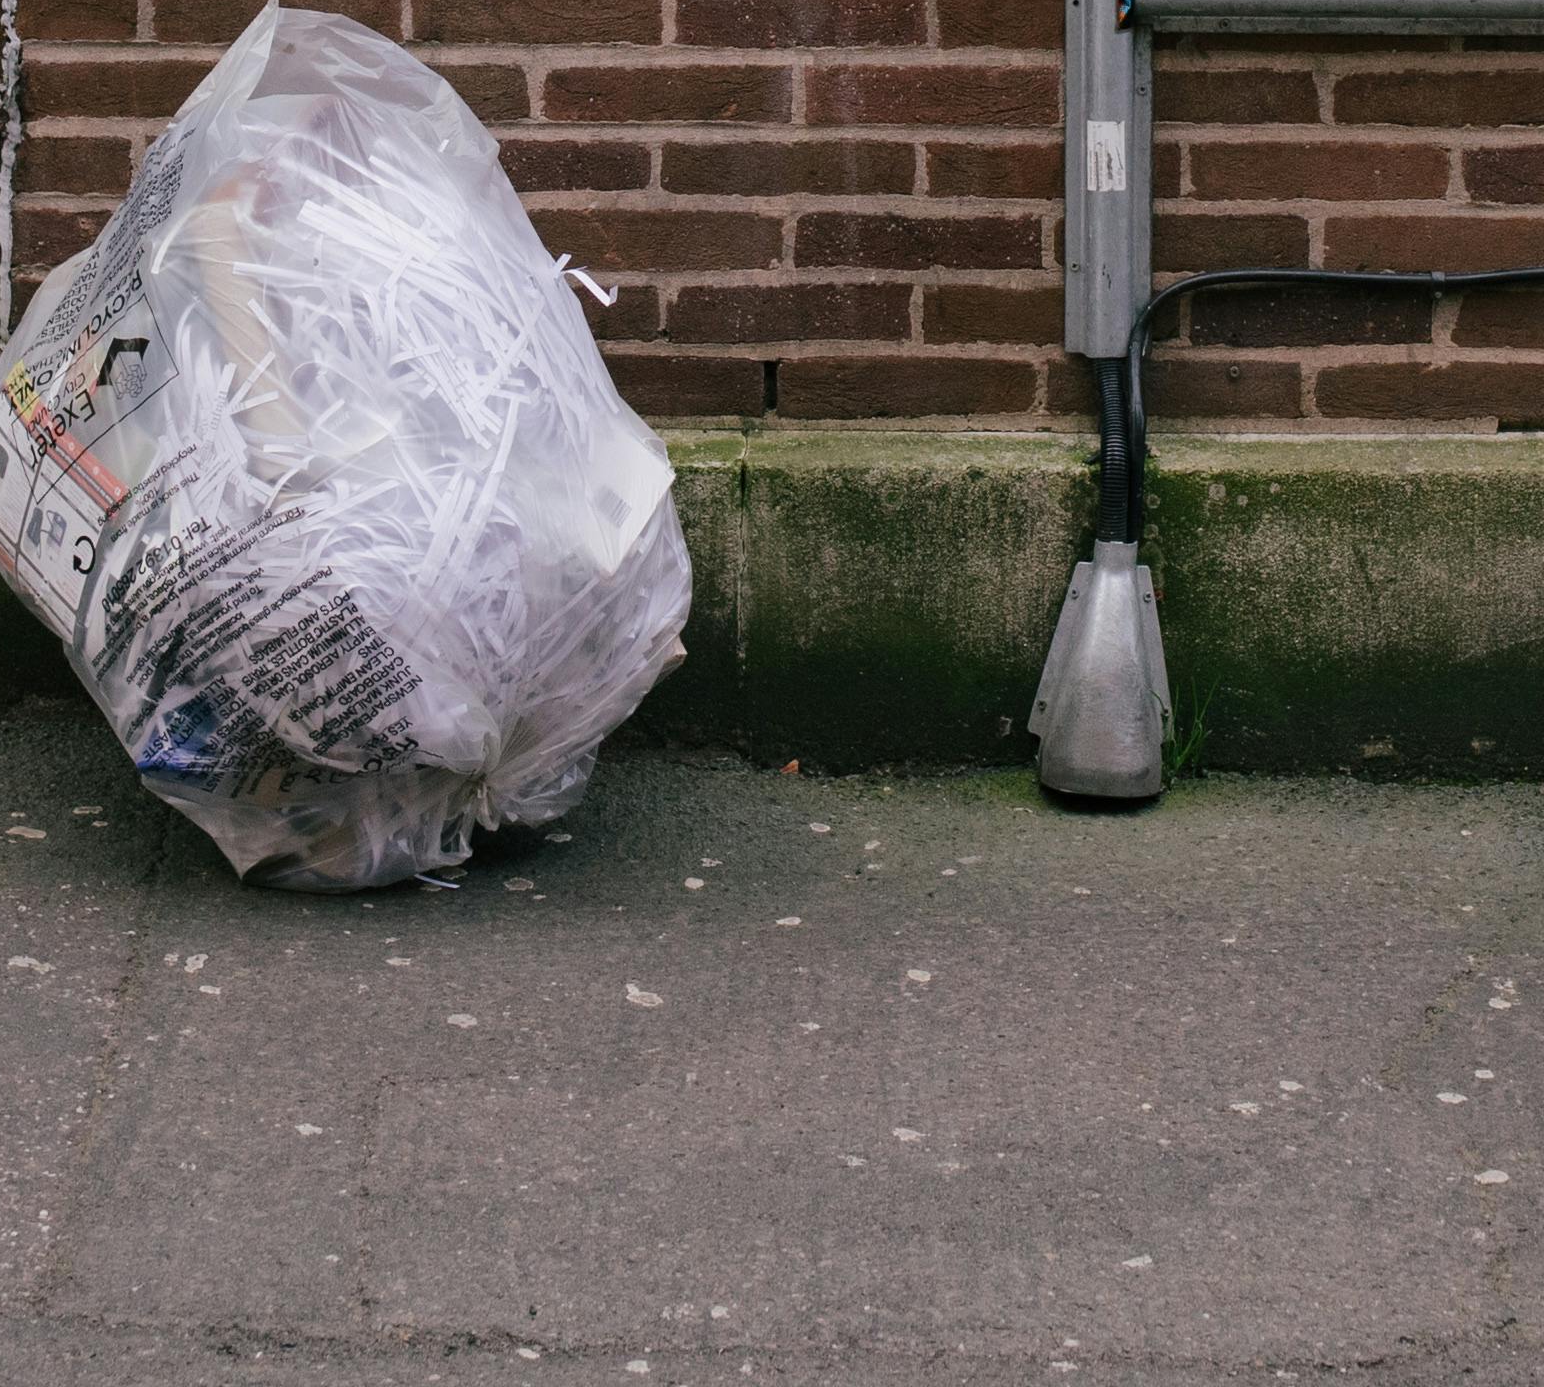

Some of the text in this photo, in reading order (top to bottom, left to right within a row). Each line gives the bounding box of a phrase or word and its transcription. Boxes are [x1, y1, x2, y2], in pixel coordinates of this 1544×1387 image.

[9, 370, 54, 415] ONLY
[63, 371, 87, 396] City
[30, 388, 96, 470] Exeter
[178, 471, 199, 489] This
[149, 499, 161, 511] is
[157, 483, 181, 504] sack
[126, 505, 152, 528] made
[204, 532, 239, 561] advice
[206, 534, 261, 573] information
[97, 514, 212, 613] Tel: 01392 265010
[175, 568, 190, 582] to
[185, 554, 210, 575] how
[194, 569, 211, 583] on
[175, 577, 199, 596] how
[247, 583, 262, 596] To
[299, 565, 333, 590] Please
[230, 590, 252, 608] find
[267, 584, 302, 611] recycle
[318, 589, 351, 617] POTS
[296, 609, 321, 631] AND
[240, 602, 358, 687] PLASTIC BOTTLES, TRAYS
[306, 613, 366, 659] ALUMINIUM
[356, 634, 386, 659] TINS
[269, 623, 376, 703] EMPTY AEROSOL CANS
[279, 652, 310, 678] CANS
[353, 644, 396, 678] CLEAN
[204, 674, 227, 696] ALL
[266, 670, 284, 687] OR
[378, 663, 414, 693] JUNK
[299, 692, 326, 715] CANS
[171, 713, 204, 747] DIRTY
[215, 705, 255, 739] NAPPIES
[141, 722, 178, 762] WASTE
